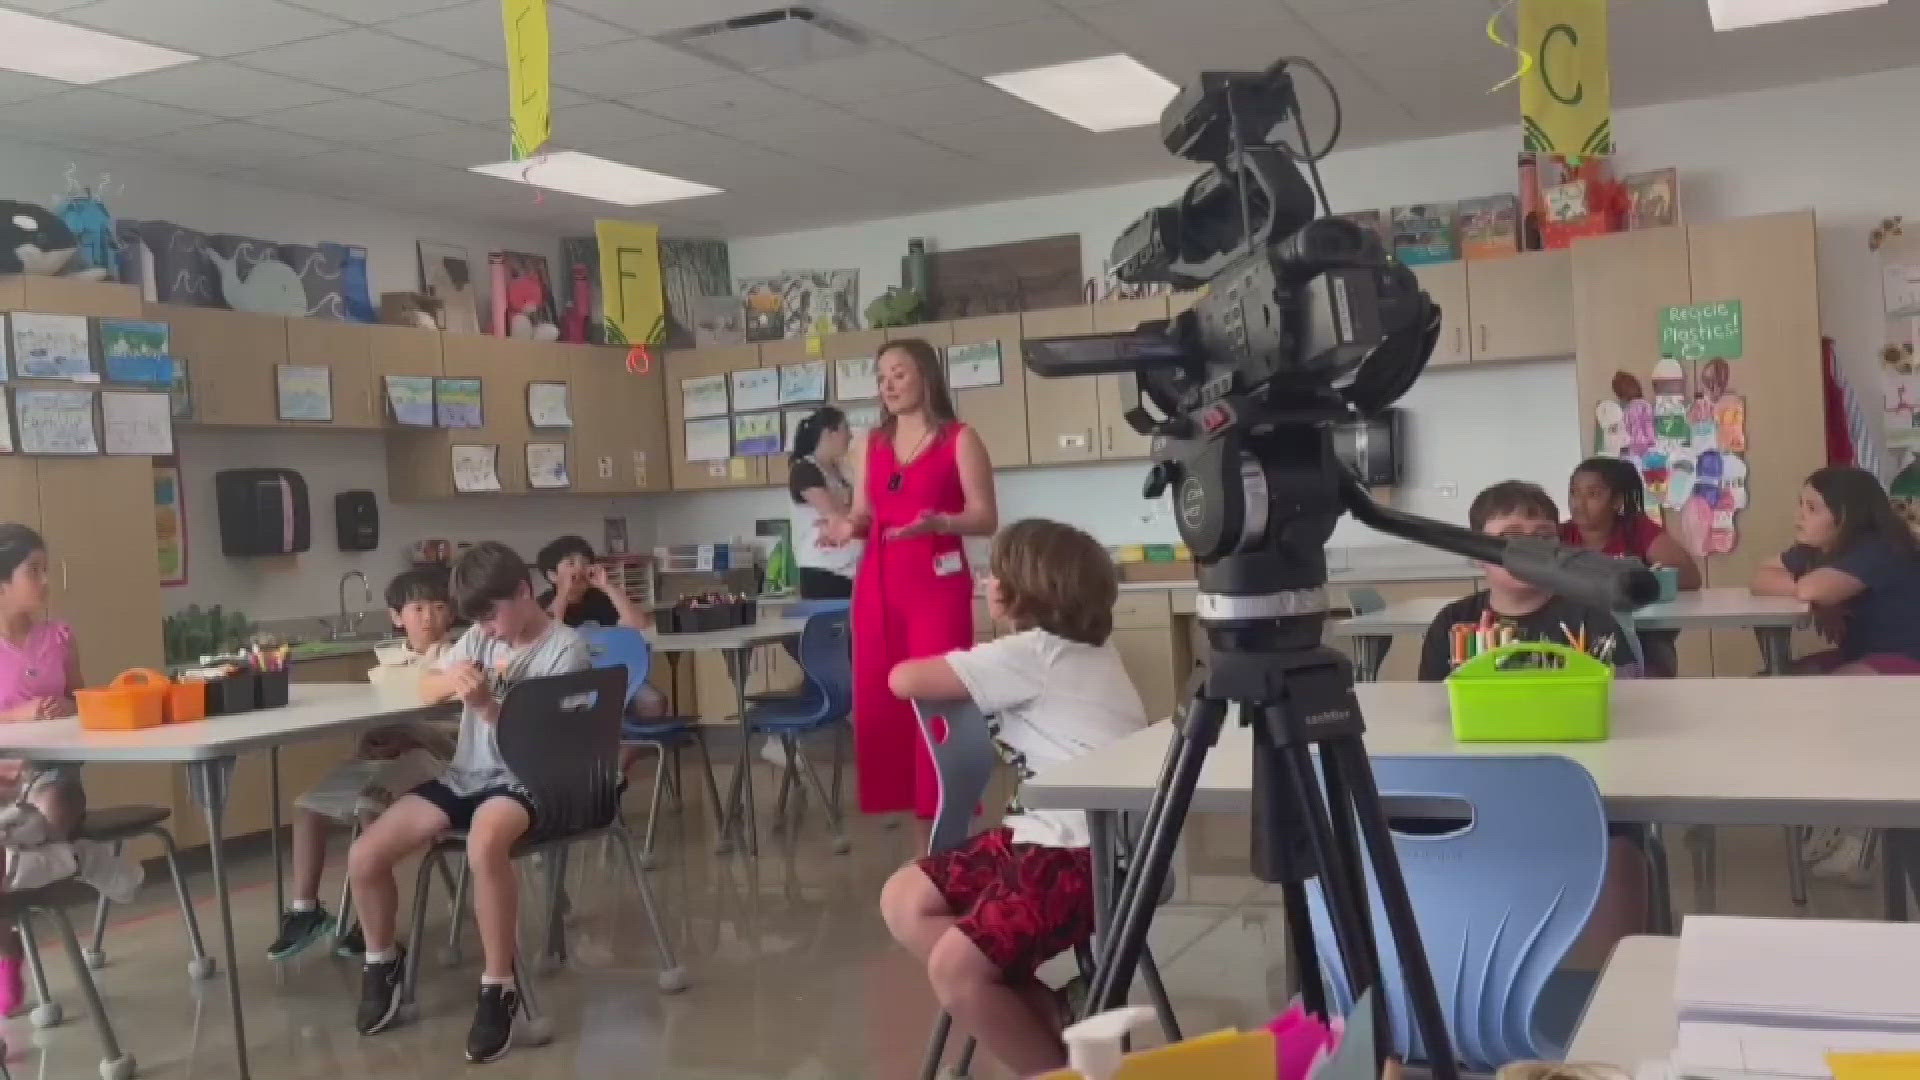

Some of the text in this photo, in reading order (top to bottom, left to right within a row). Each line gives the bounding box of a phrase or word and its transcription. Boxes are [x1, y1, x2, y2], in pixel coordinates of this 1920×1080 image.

[515, 5, 539, 106] E
[1539, 23, 1583, 105] C
[616, 247, 643, 324] F
